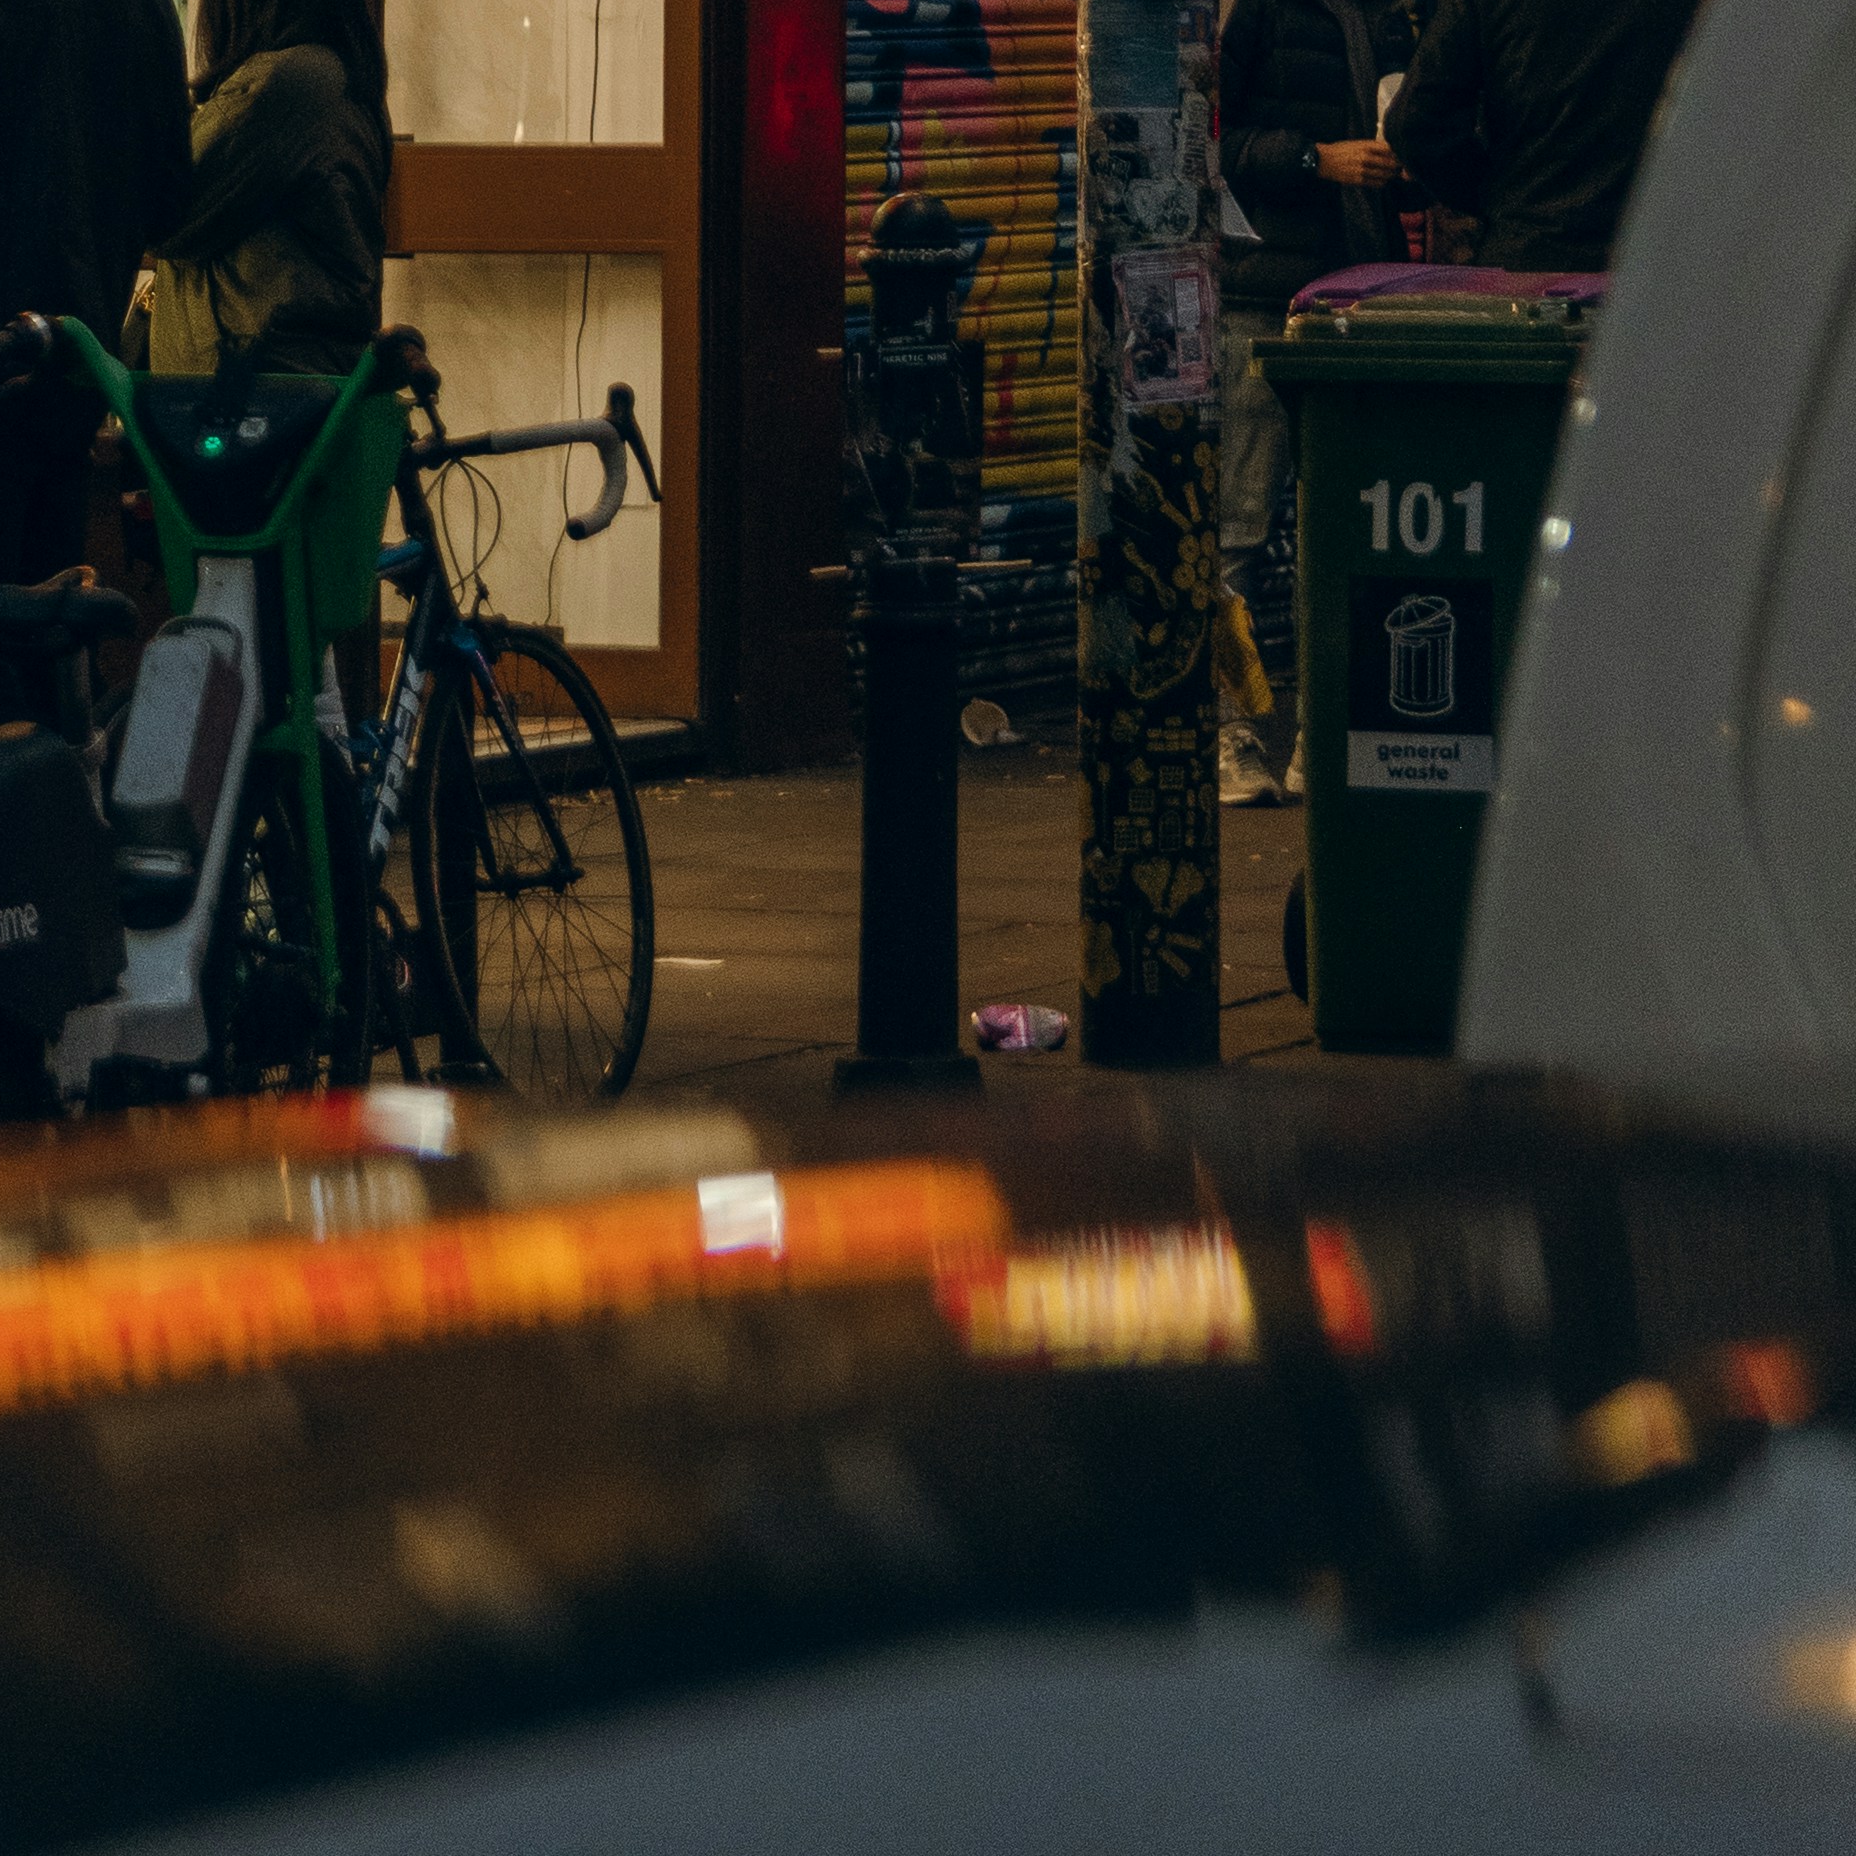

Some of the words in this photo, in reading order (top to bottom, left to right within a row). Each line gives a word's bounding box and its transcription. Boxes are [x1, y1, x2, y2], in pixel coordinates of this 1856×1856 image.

[1360, 478, 1486, 558] 101
[1377, 740, 1460, 765] general
[1387, 759, 1450, 782] waste
